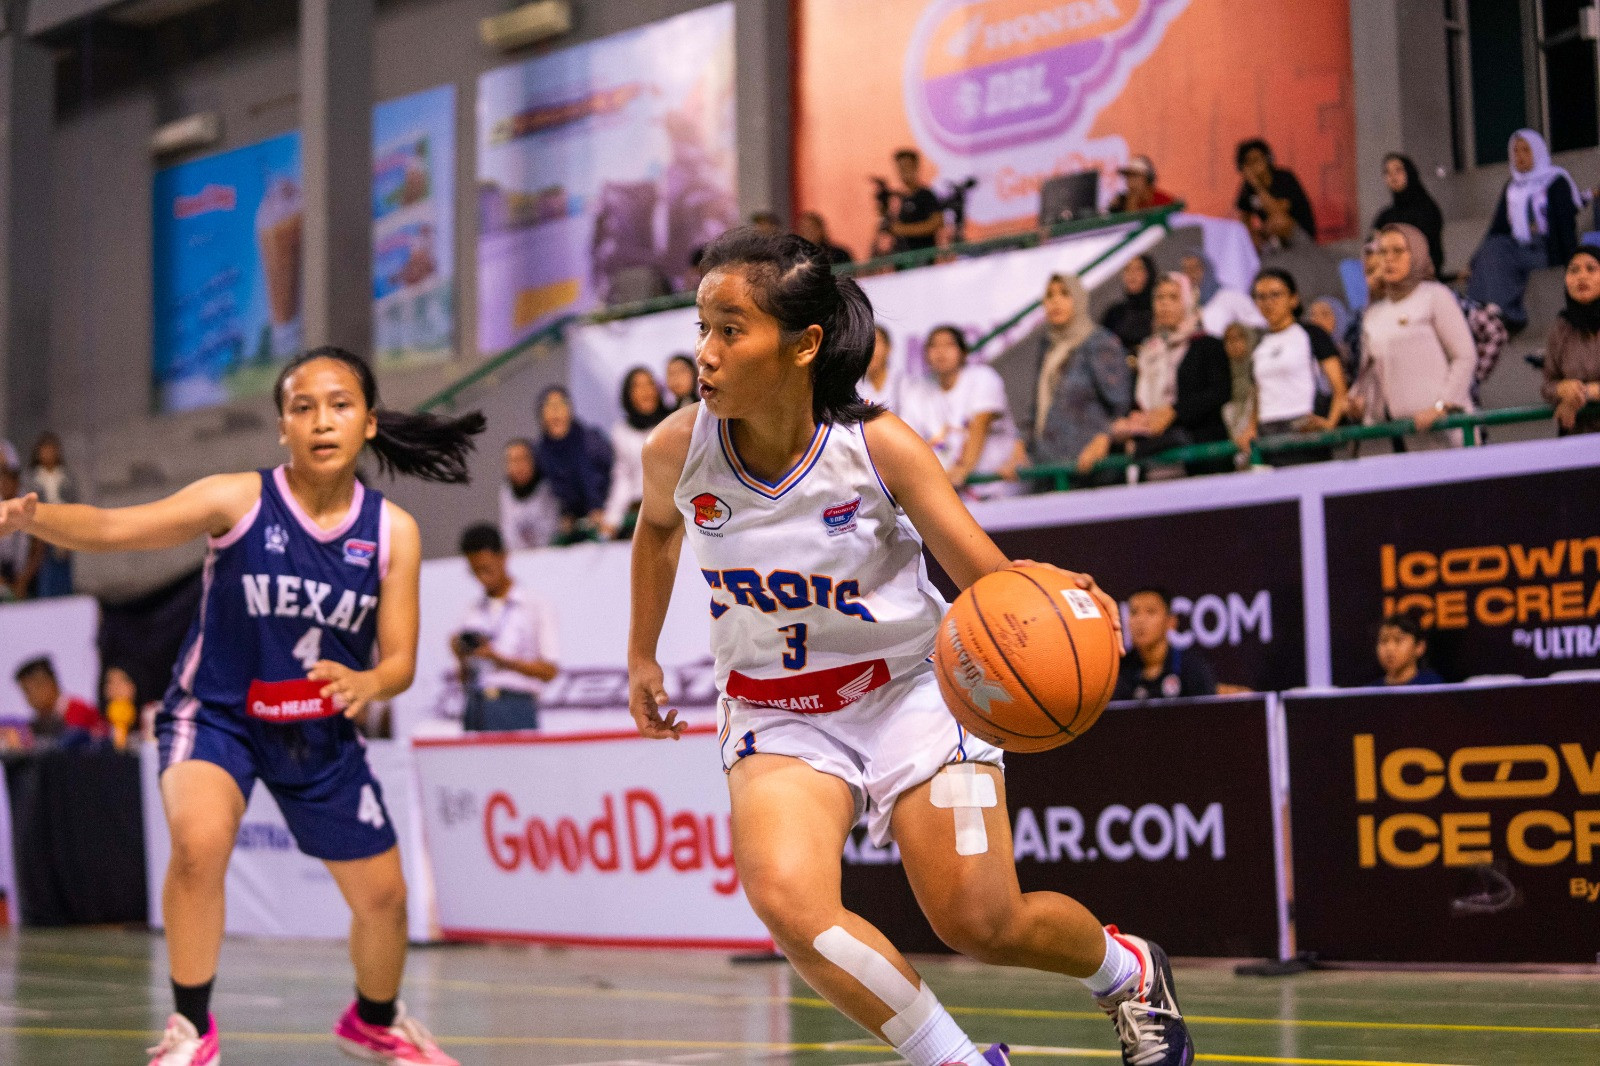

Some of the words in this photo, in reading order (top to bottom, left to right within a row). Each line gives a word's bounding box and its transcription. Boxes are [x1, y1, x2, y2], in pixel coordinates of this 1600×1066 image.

[698, 529, 724, 538] EMBANG
[241, 573, 378, 633] NEXAT
[291, 626, 323, 670] 4
[777, 622, 808, 671] 3
[357, 783, 385, 830] 4
[1357, 812, 1494, 869] ICE
